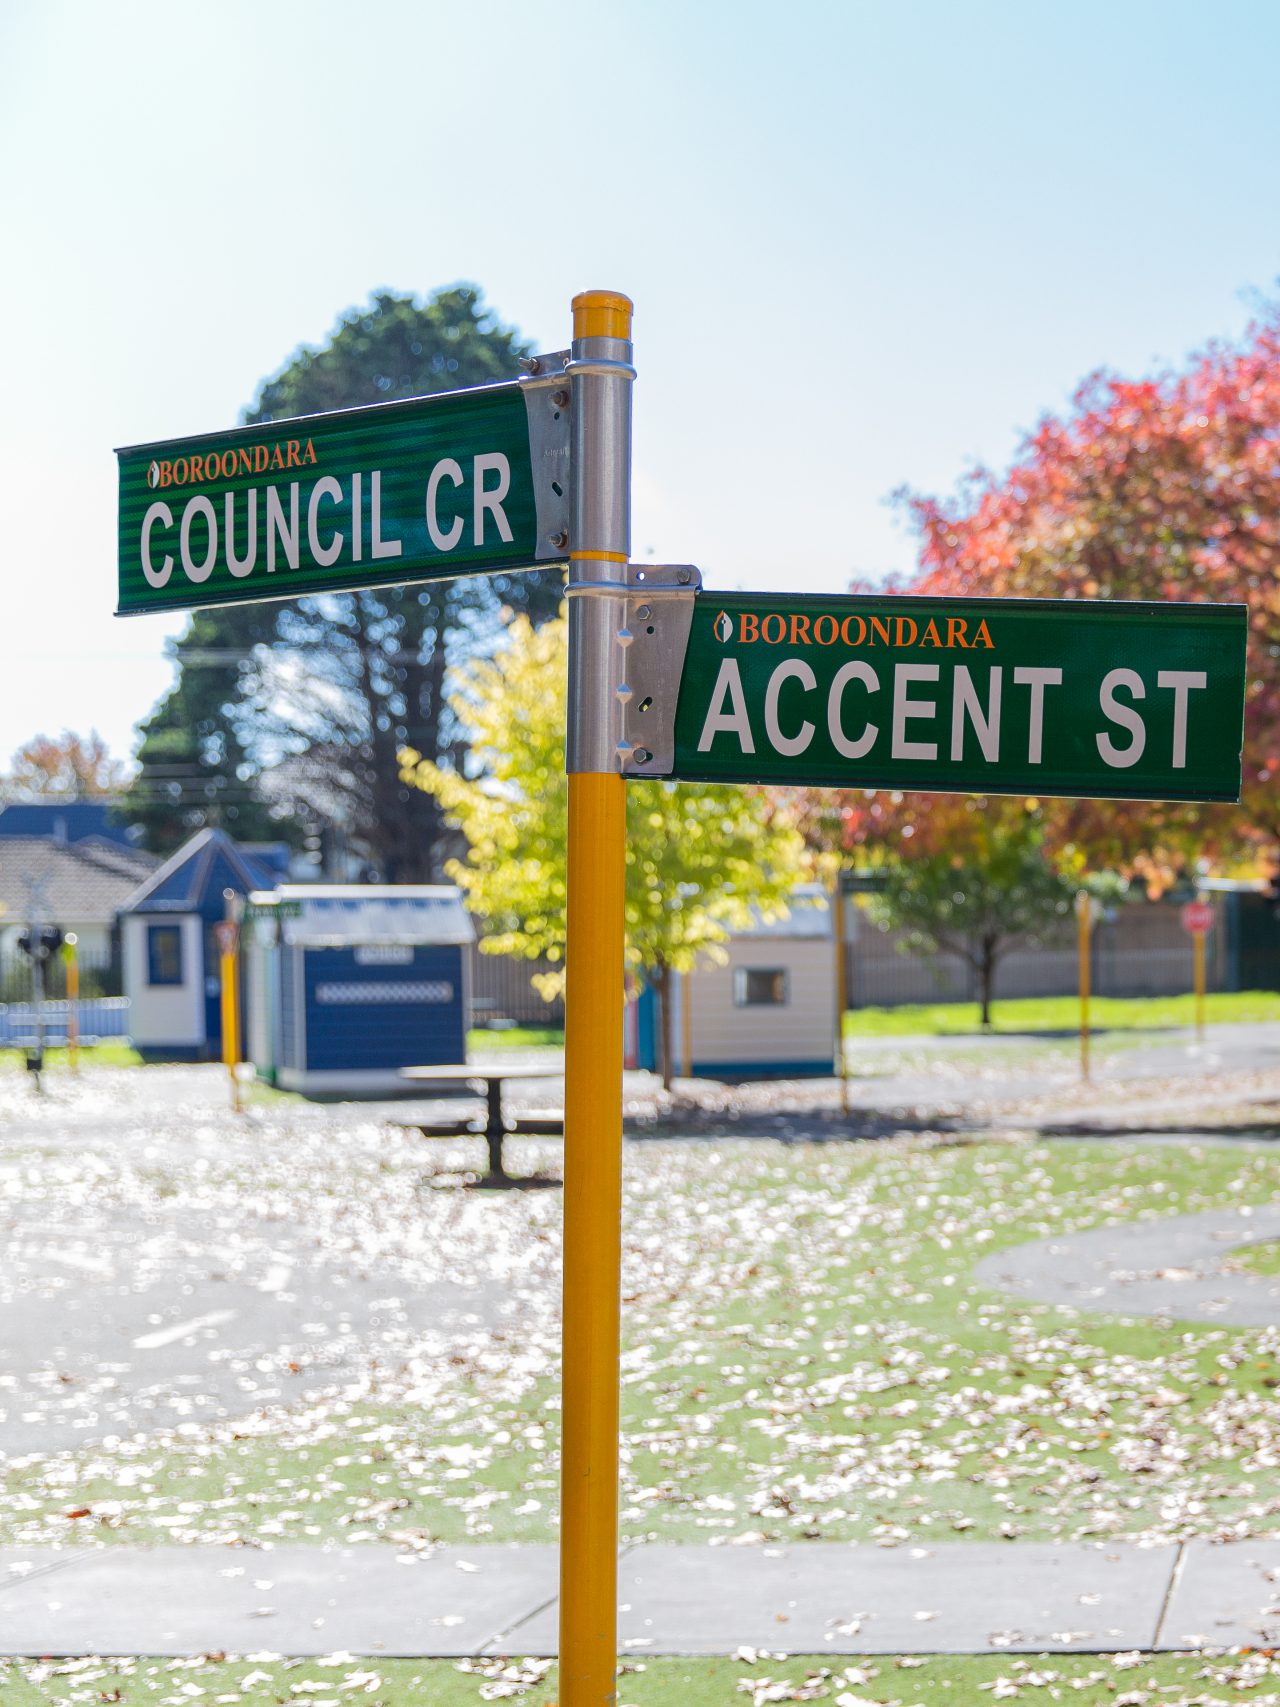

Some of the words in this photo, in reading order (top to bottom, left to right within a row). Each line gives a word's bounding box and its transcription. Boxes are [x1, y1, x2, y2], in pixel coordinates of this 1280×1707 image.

[158, 438, 318, 488] BOROONDARA
[140, 471, 402, 589] COUNCIL
[426, 451, 514, 552] CR
[737, 613, 996, 650] BOROONDARA
[697, 657, 1063, 764] ACCENT
[1095, 667, 1207, 769] ST
